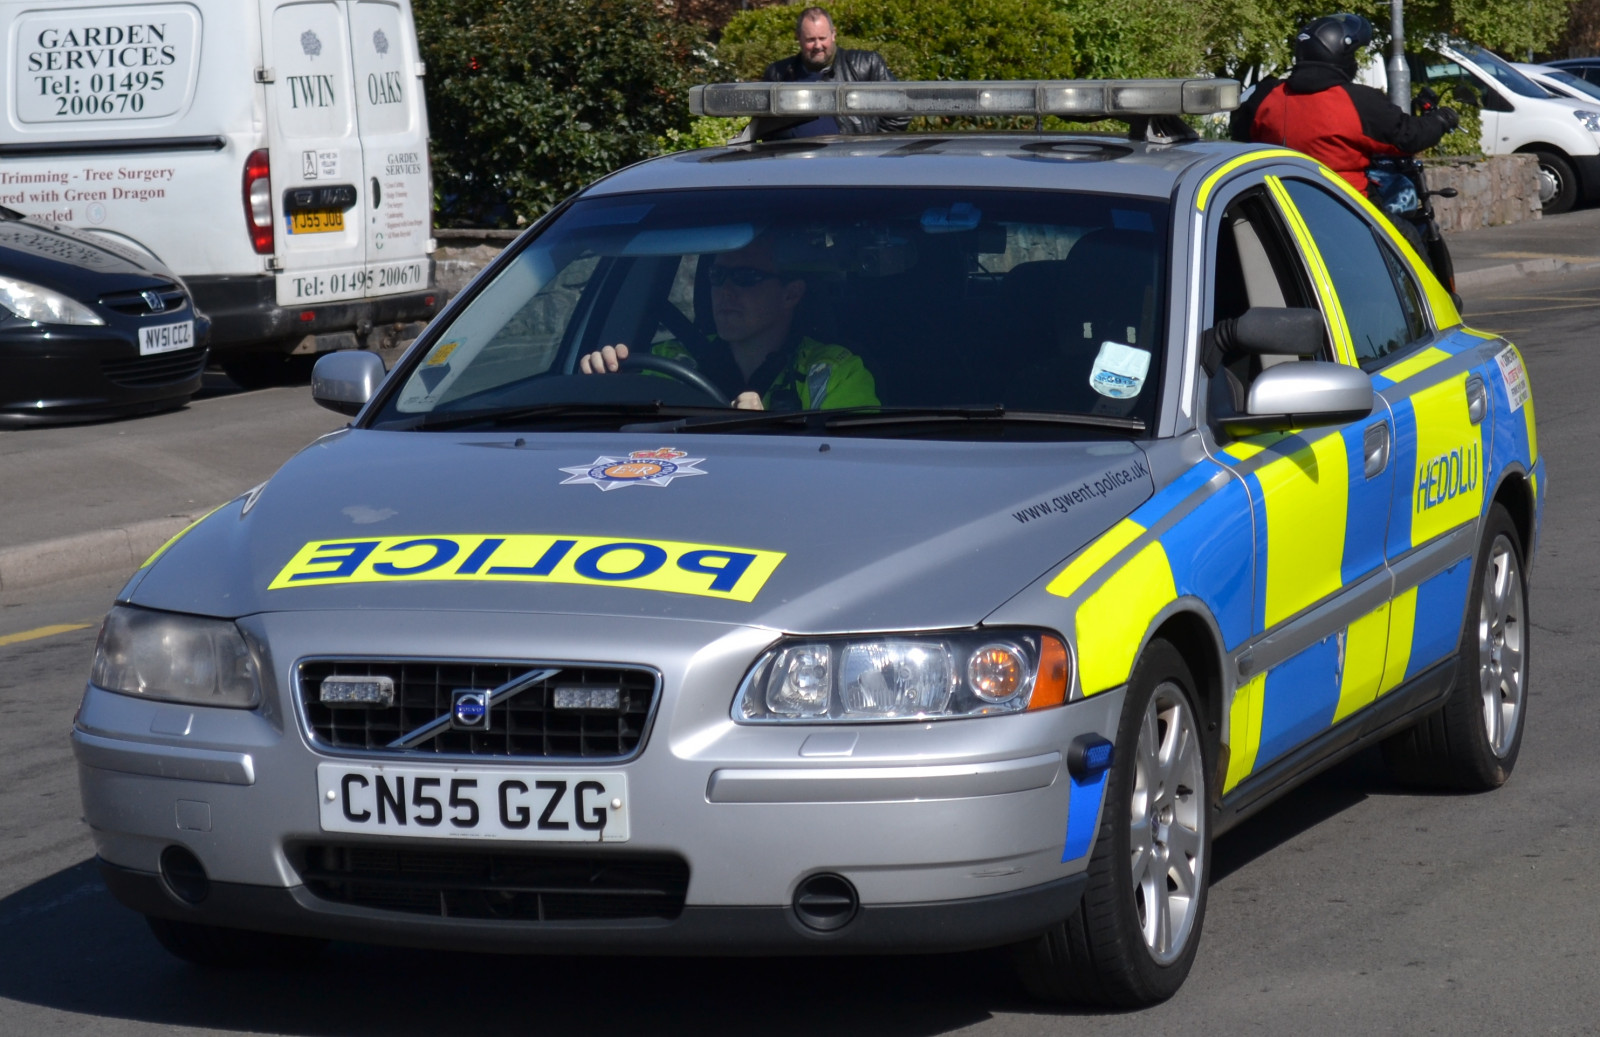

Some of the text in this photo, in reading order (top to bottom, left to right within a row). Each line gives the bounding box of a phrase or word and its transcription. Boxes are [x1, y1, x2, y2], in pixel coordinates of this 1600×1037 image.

[37, 23, 167, 49] GARDEN
[28, 45, 176, 72] SERVICES
[34, 70, 164, 96] Tel: 01495
[286, 70, 402, 109] TWIN OAKS
[55, 92, 144, 116] 200670
[385, 164, 421, 176] SERVICES
[387, 152, 419, 165] GARDEN
[0, 171, 69, 185] Trimming
[82, 168, 114, 181] Tree
[117, 167, 176, 182] Surgery
[0, 187, 165, 204] red with Green Dragon
[292, 208, 320, 229] YJ55
[293, 264, 421, 298] Tel: 01495 200670
[1417, 441, 1478, 514] HEDDLU
[1012, 460, 1149, 524] www.gwent.police.uk
[341, 773, 607, 830] CN55 GZG
